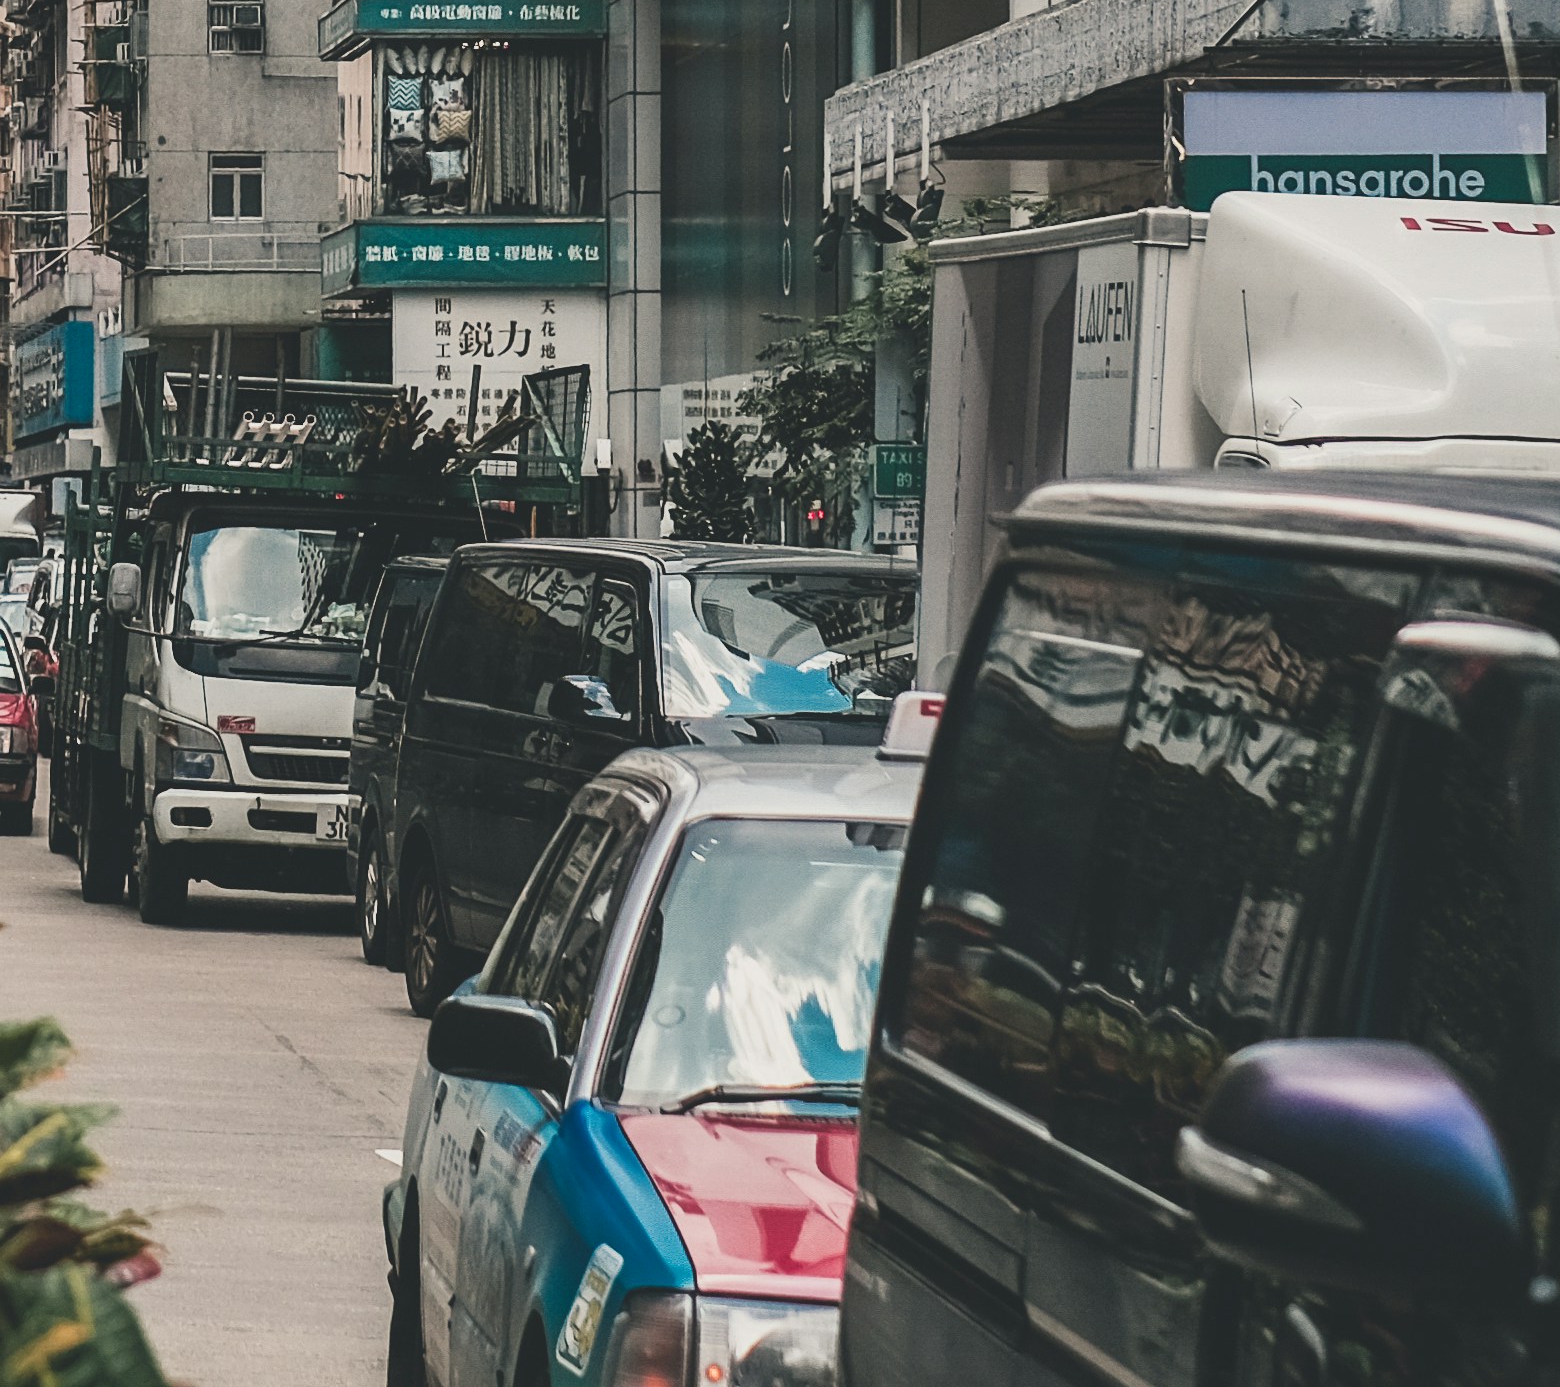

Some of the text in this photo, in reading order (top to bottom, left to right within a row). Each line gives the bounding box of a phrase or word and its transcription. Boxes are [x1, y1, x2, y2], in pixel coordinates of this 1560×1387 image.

[1250, 154, 1486, 198] hansgrohe
[1078, 280, 1134, 344] LAUFEN
[881, 451, 912, 466] TAXI
[335, 805, 348, 822] N
